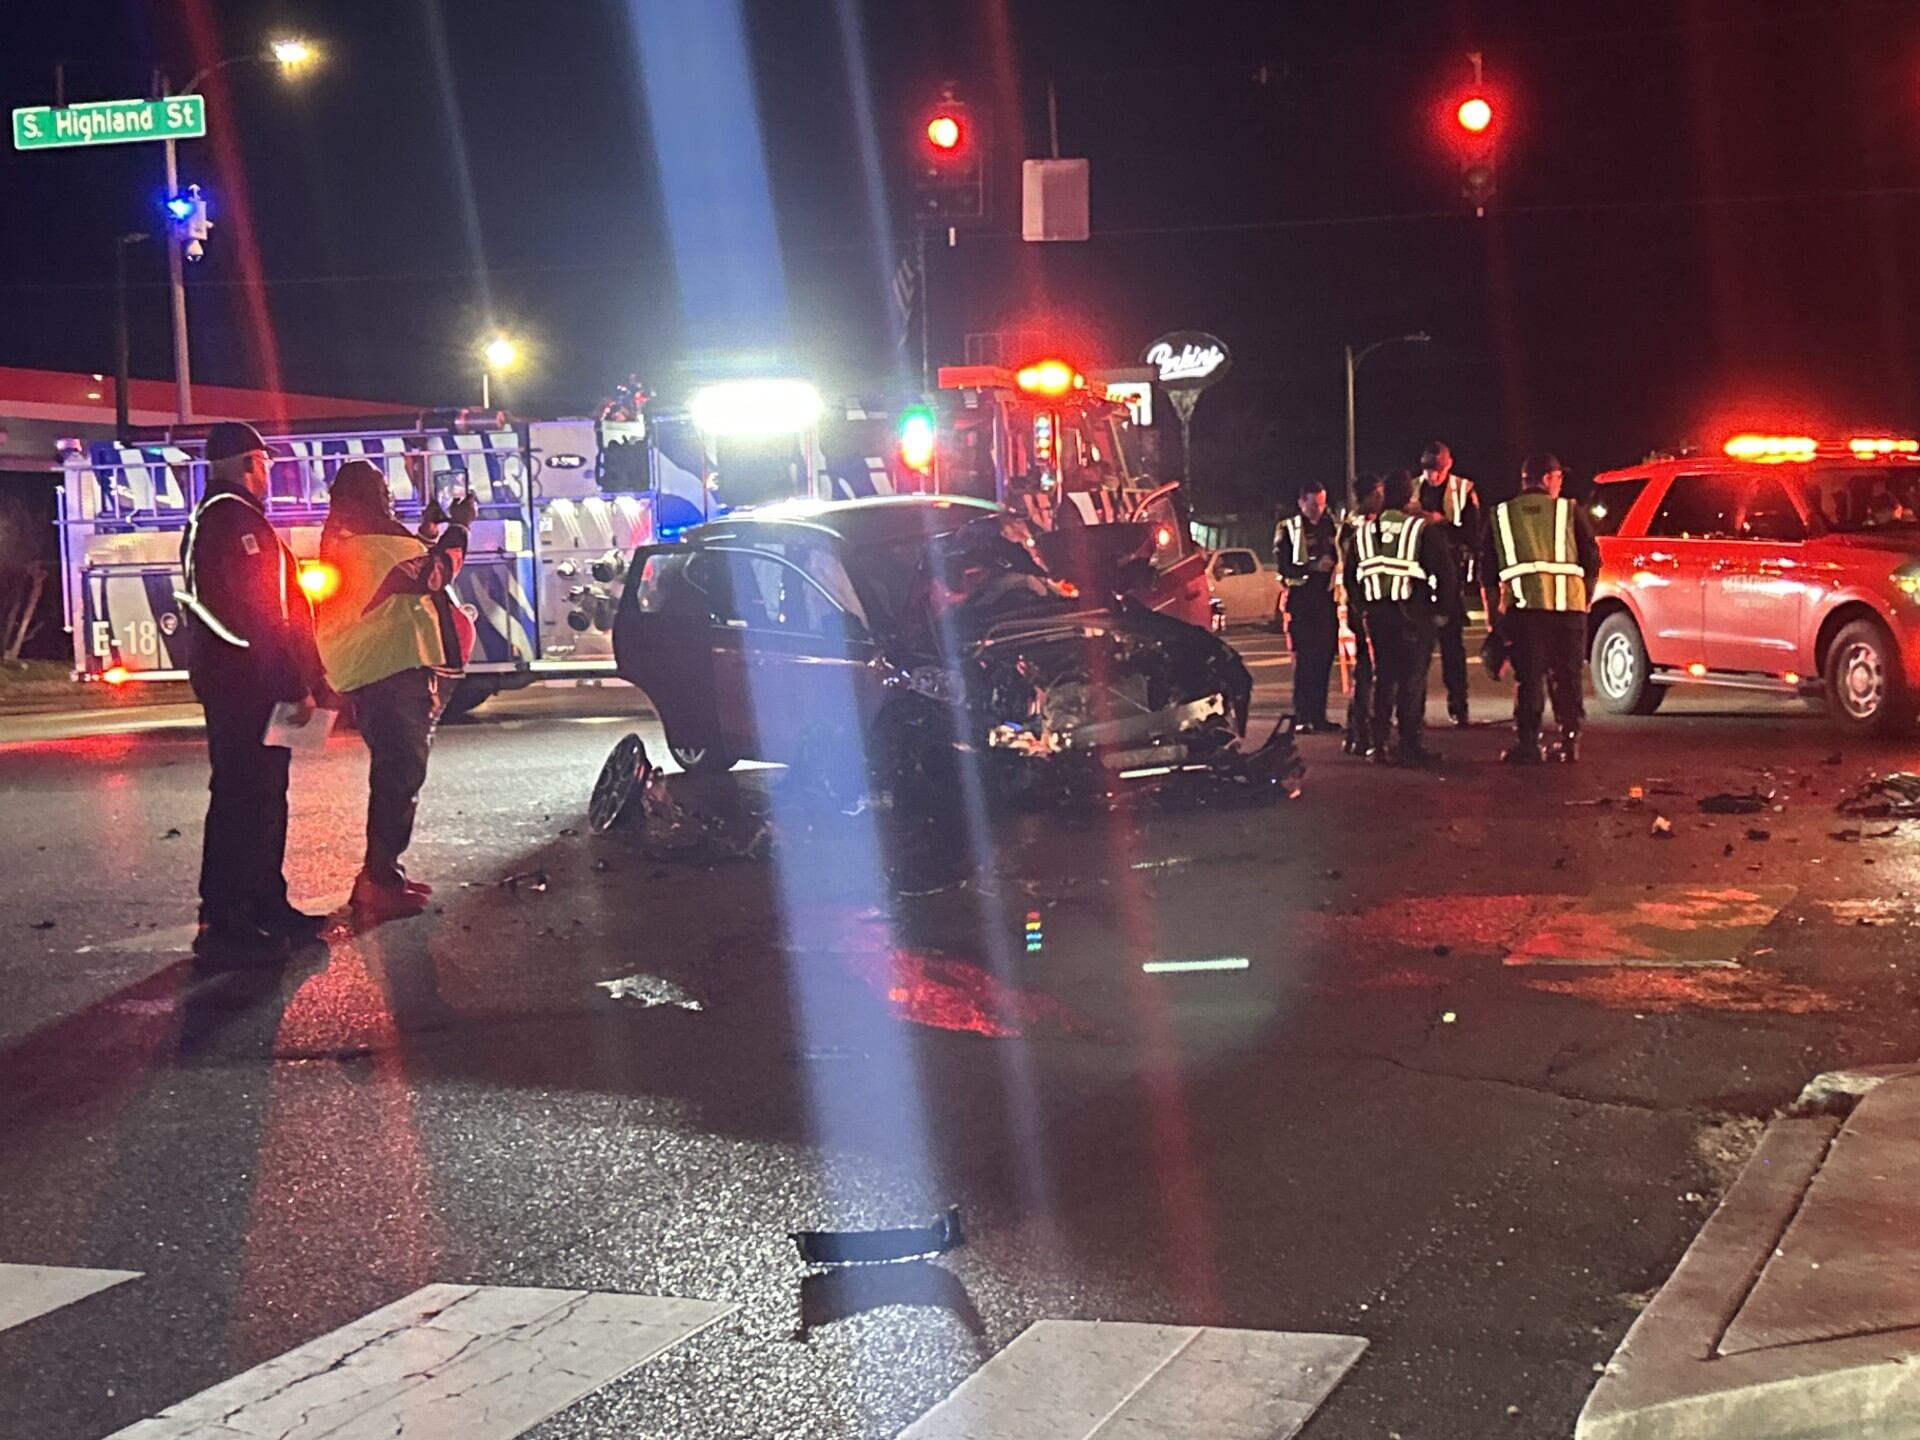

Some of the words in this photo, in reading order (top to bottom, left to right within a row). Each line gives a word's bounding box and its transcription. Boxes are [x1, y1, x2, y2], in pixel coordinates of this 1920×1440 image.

[23, 112, 43, 139] S.
[56, 106, 153, 142] Highland
[166, 103, 195, 128] St
[92, 620, 158, 657] E-18
